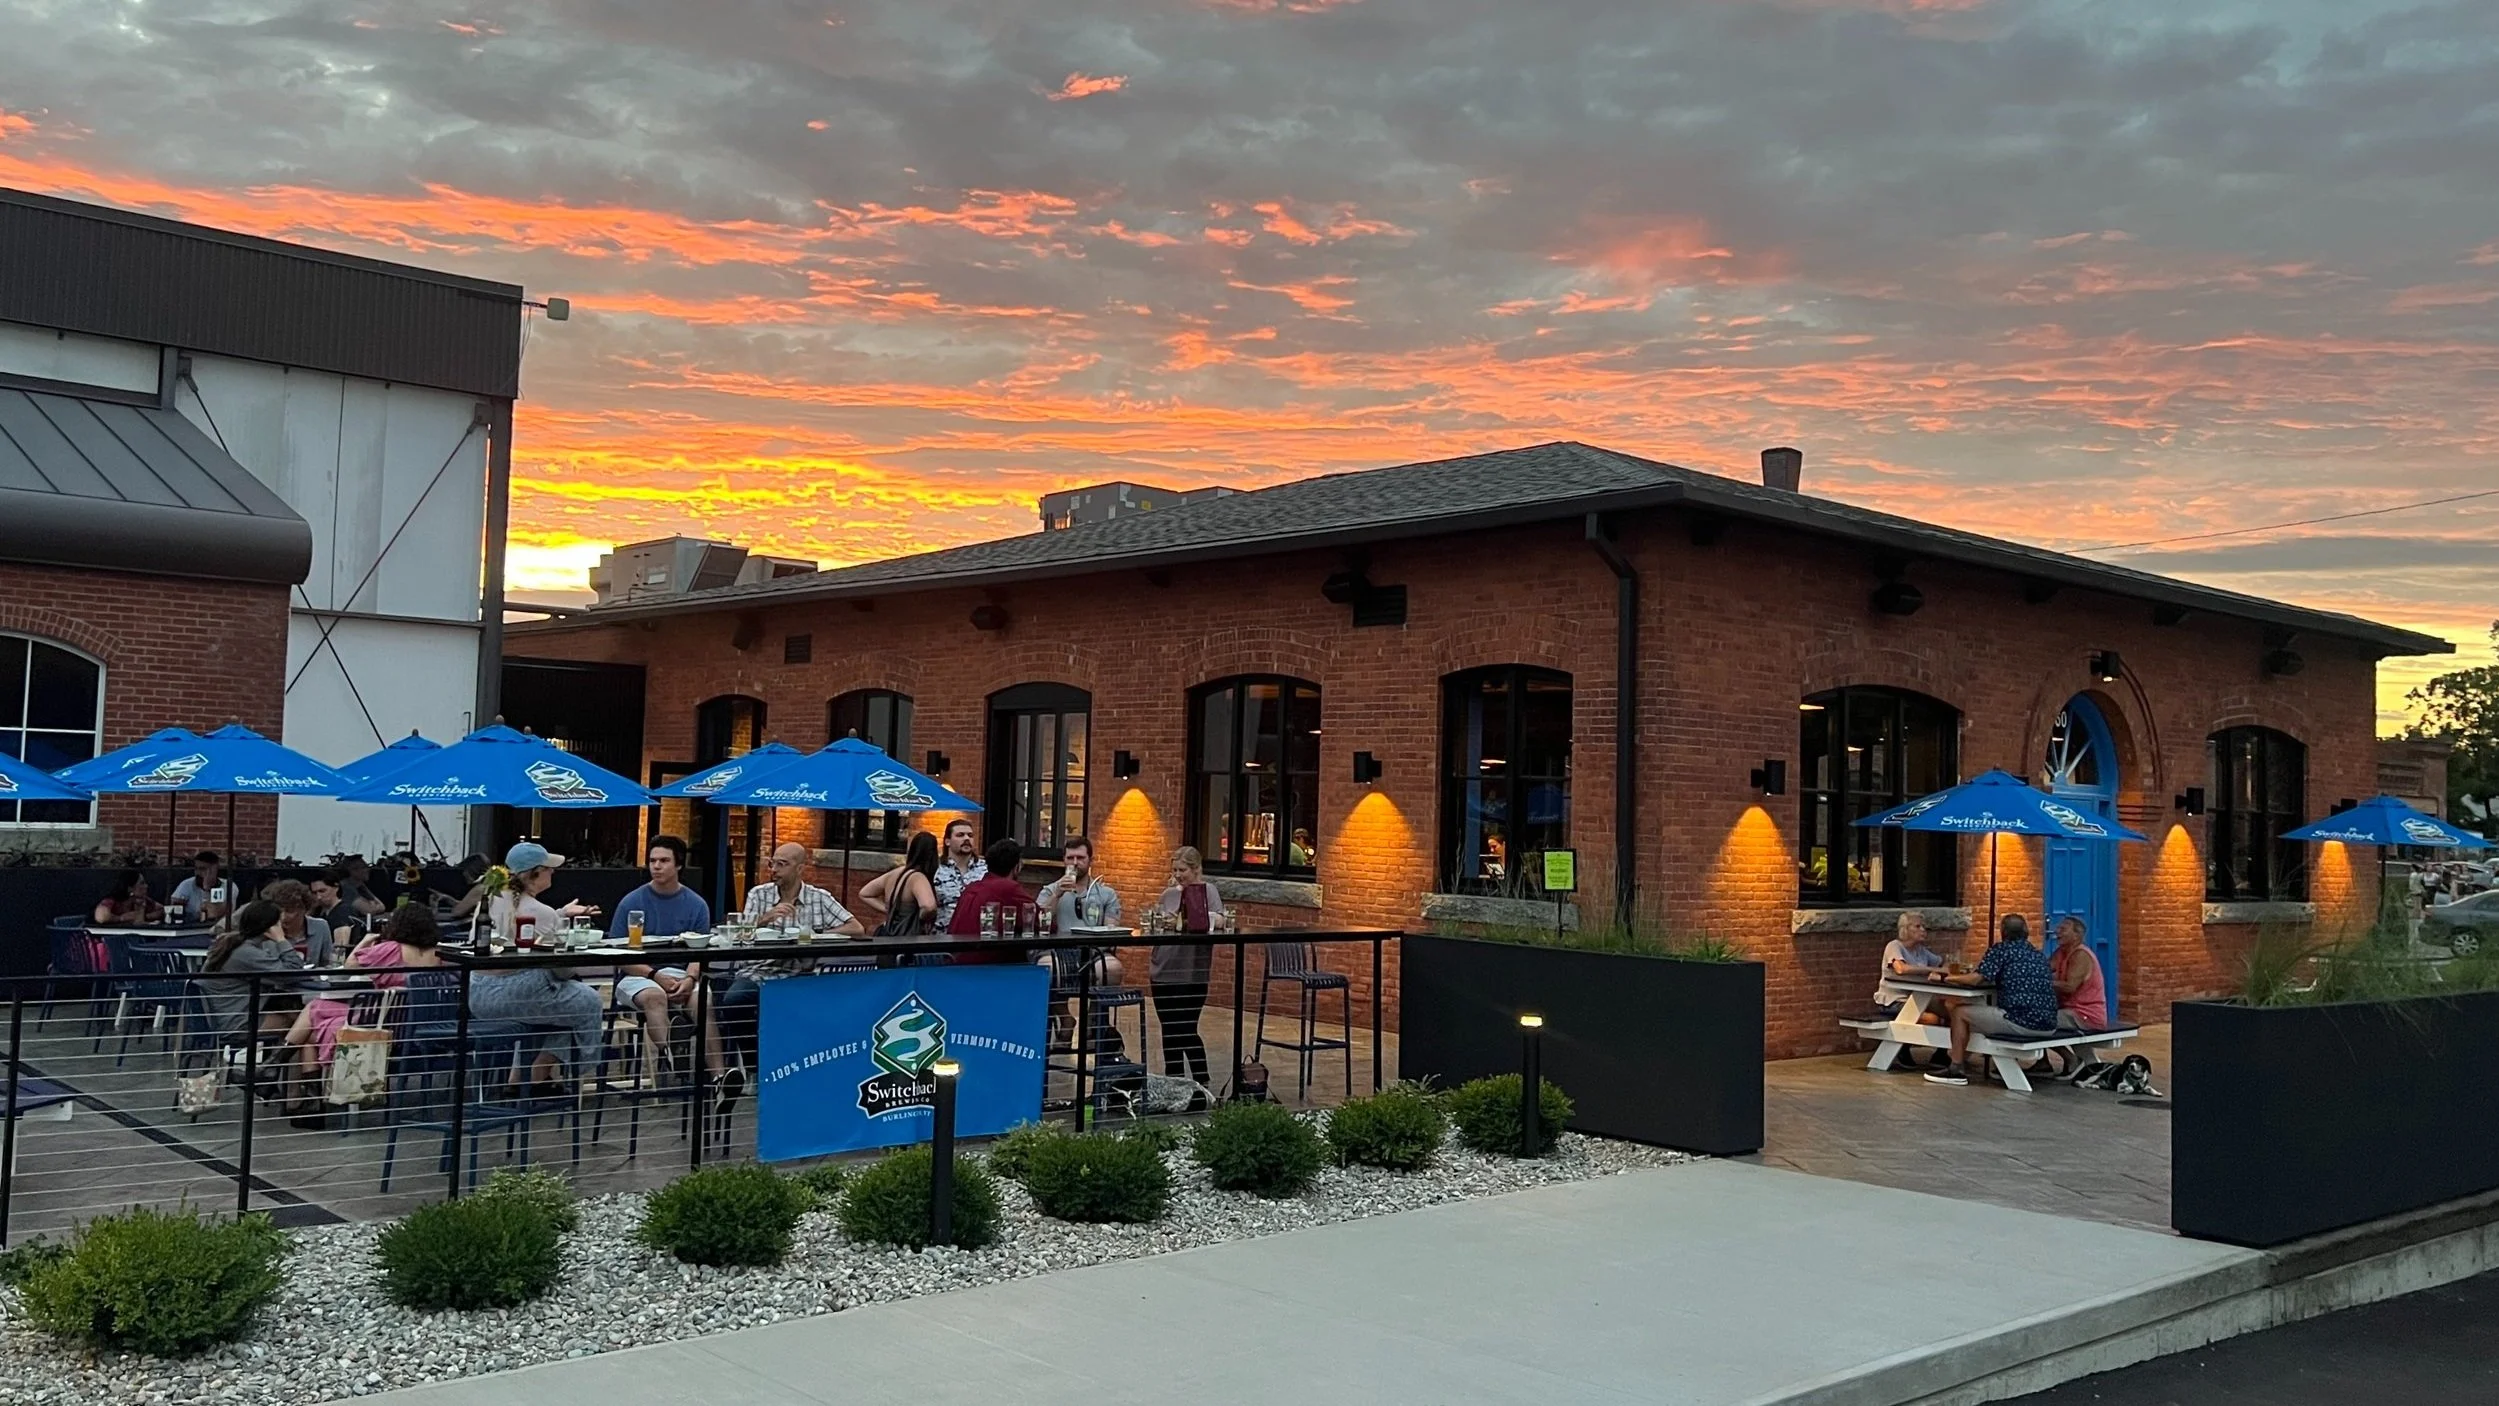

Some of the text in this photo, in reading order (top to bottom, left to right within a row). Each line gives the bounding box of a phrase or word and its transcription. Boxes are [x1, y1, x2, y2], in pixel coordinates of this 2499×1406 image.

[234, 776, 328, 788] Switchback
[388, 784, 487, 798] Switchback
[749, 788, 829, 801] Switchback
[1940, 816, 2030, 829] Switchback
[213, 890, 222, 900] 41
[771, 1062, 800, 1083] 100%
[803, 1042, 858, 1069] EMPLOYEE
[950, 1033, 998, 1050] VERMONT
[1001, 1041, 1035, 1060] OWNED
